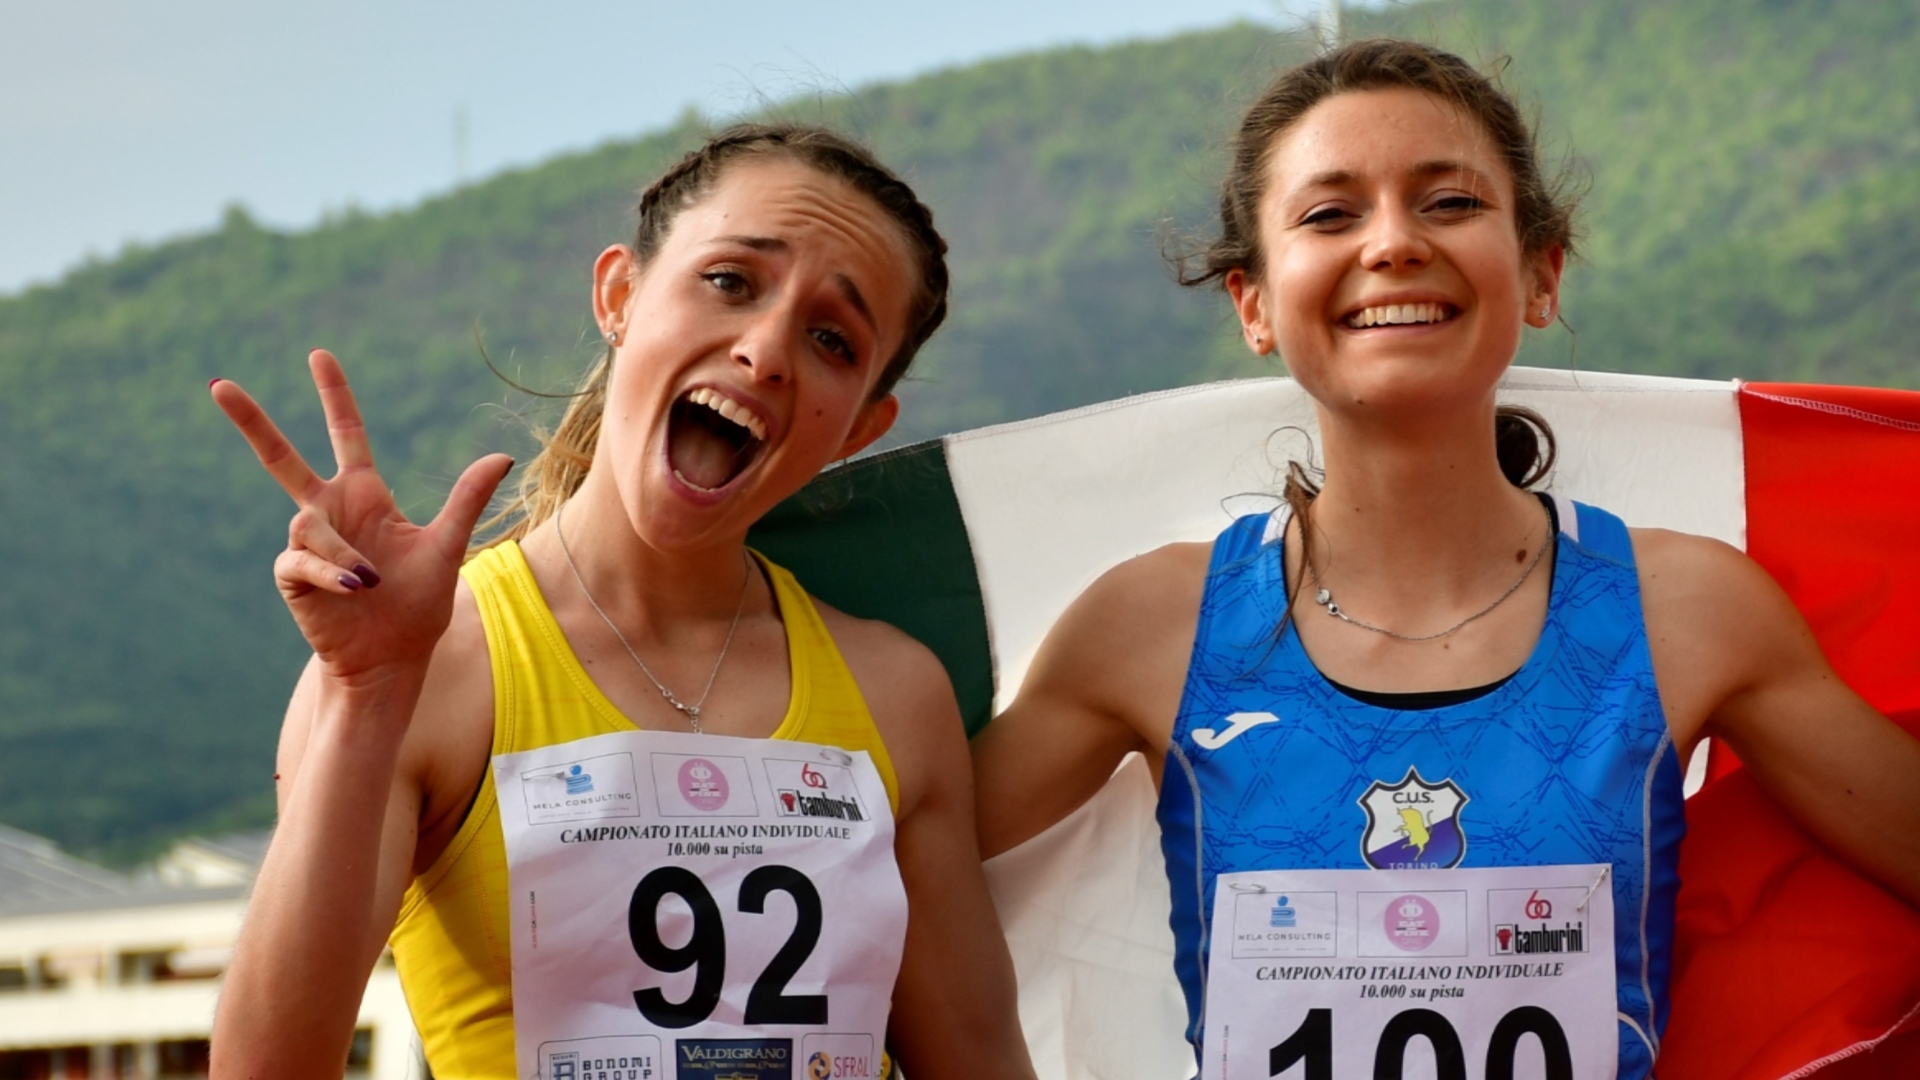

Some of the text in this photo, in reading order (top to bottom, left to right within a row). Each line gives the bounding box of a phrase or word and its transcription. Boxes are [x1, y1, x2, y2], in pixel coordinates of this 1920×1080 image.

[533, 792, 632, 810] MELA CONSULTING
[796, 790, 864, 822] tamburini
[1392, 791, 1435, 804] C.U.S.
[560, 825, 852, 843] CAMPIONATO ITALIANO INDIVIDUALE
[666, 842, 764, 859] 10.000 su pista
[1388, 862, 1439, 870] TORINO
[1237, 932, 1331, 941] MELA CONSULTING
[1514, 921, 1583, 954] tamburini
[628, 864, 829, 1029] 92
[1256, 962, 1564, 981] CAMPIONATO ITALIANO INDIVIDUALE
[1360, 984, 1465, 1001] 10.000 su pista
[681, 1045, 787, 1061] VALDIGRANO
[582, 1056, 652, 1071] BONOMI
[834, 1056, 869, 1078] SIFRAL
[583, 1069, 652, 1080] GROUP
